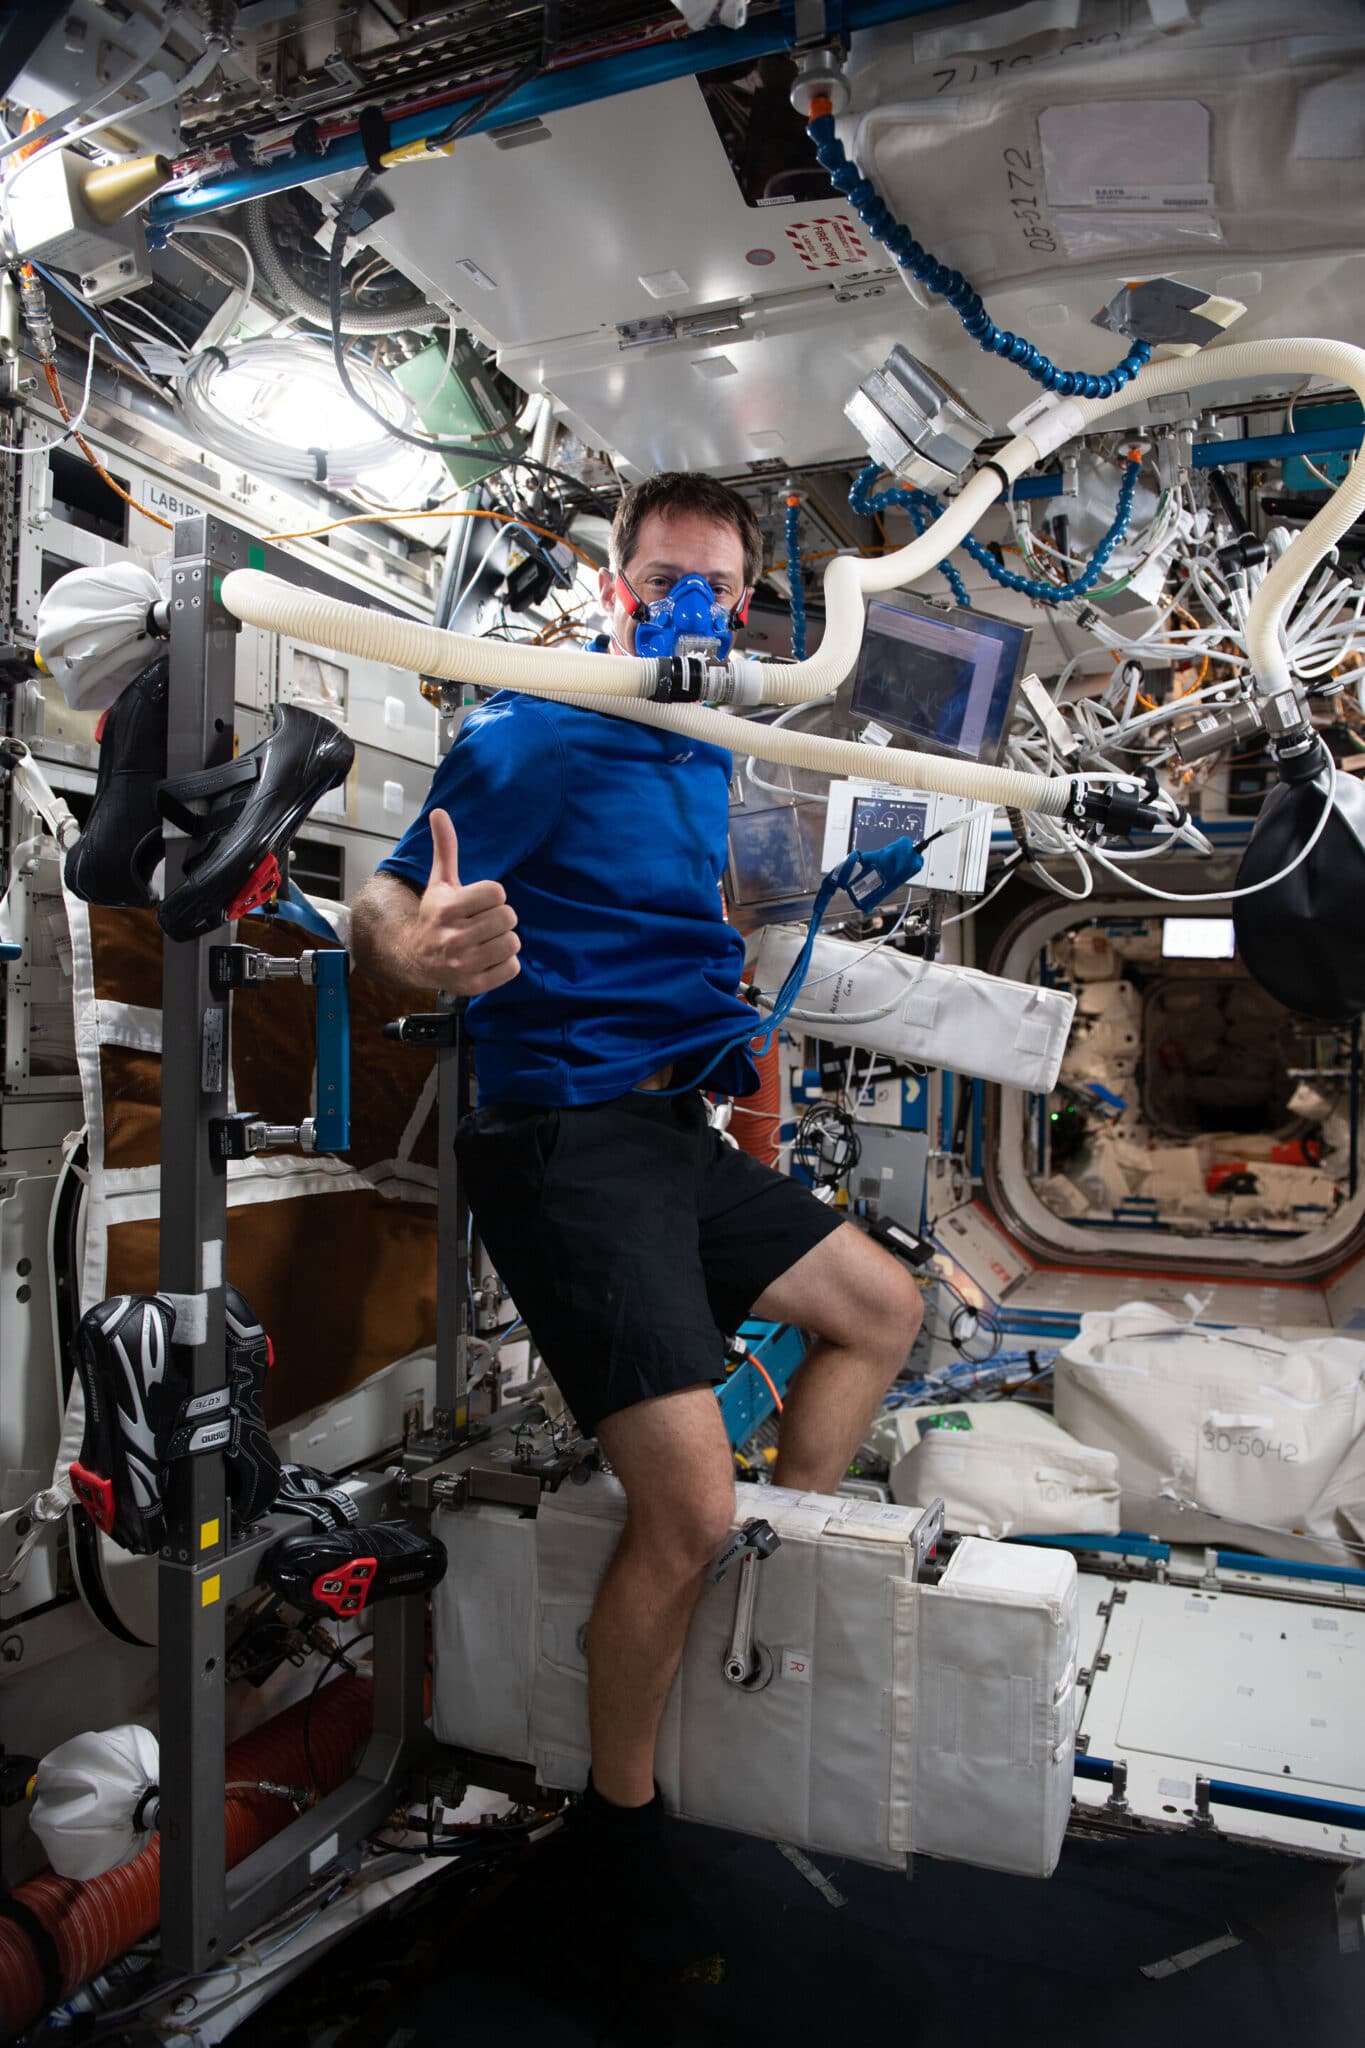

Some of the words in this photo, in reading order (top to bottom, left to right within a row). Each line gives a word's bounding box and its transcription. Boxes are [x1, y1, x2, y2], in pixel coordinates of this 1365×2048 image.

[813, 226, 829, 242] FIRE
[822, 242, 840, 260] PORT
[790, 1660, 805, 1673] R
